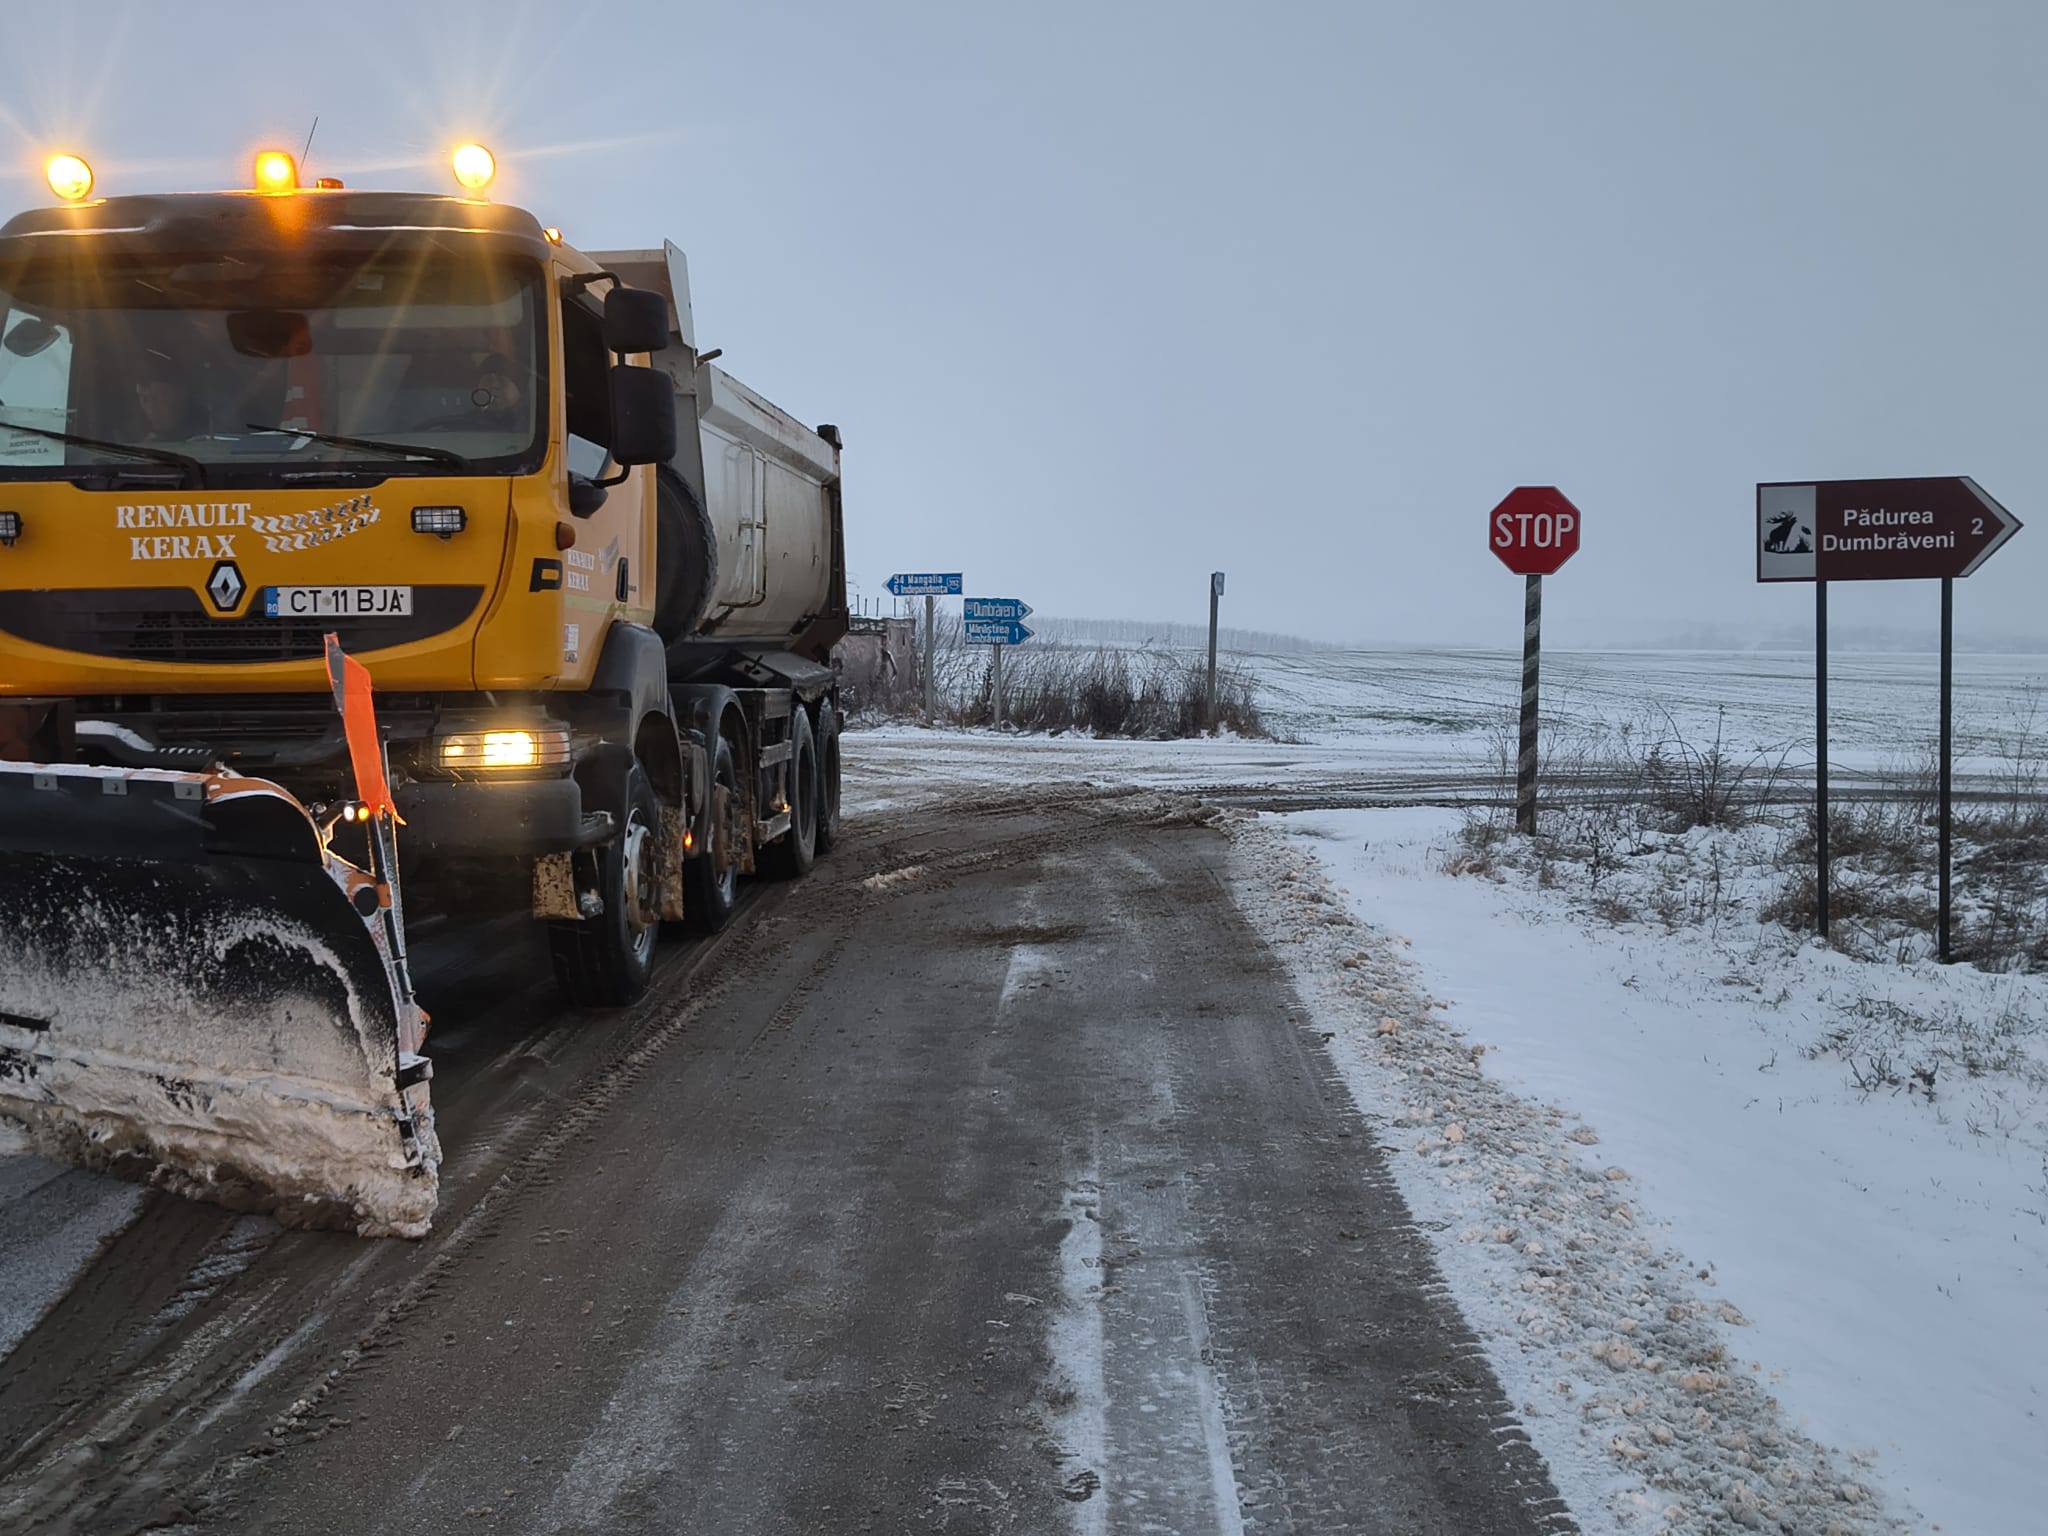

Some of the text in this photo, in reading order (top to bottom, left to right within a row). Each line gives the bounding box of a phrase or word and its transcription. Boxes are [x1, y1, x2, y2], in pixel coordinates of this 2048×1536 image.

[116, 503, 251, 529] RENAULT
[1843, 508, 1934, 526] Pădurea
[1495, 513, 1574, 548] STOP
[1971, 518, 1984, 535] 2
[130, 535, 236, 560] KERAX
[1822, 531, 1955, 552] Dumbrăveni
[907, 575, 943, 586] Mangalia
[267, 603, 278, 613] RO
[290, 589, 402, 613] CT 11 BJA
[1014, 627, 1019, 641] 1
